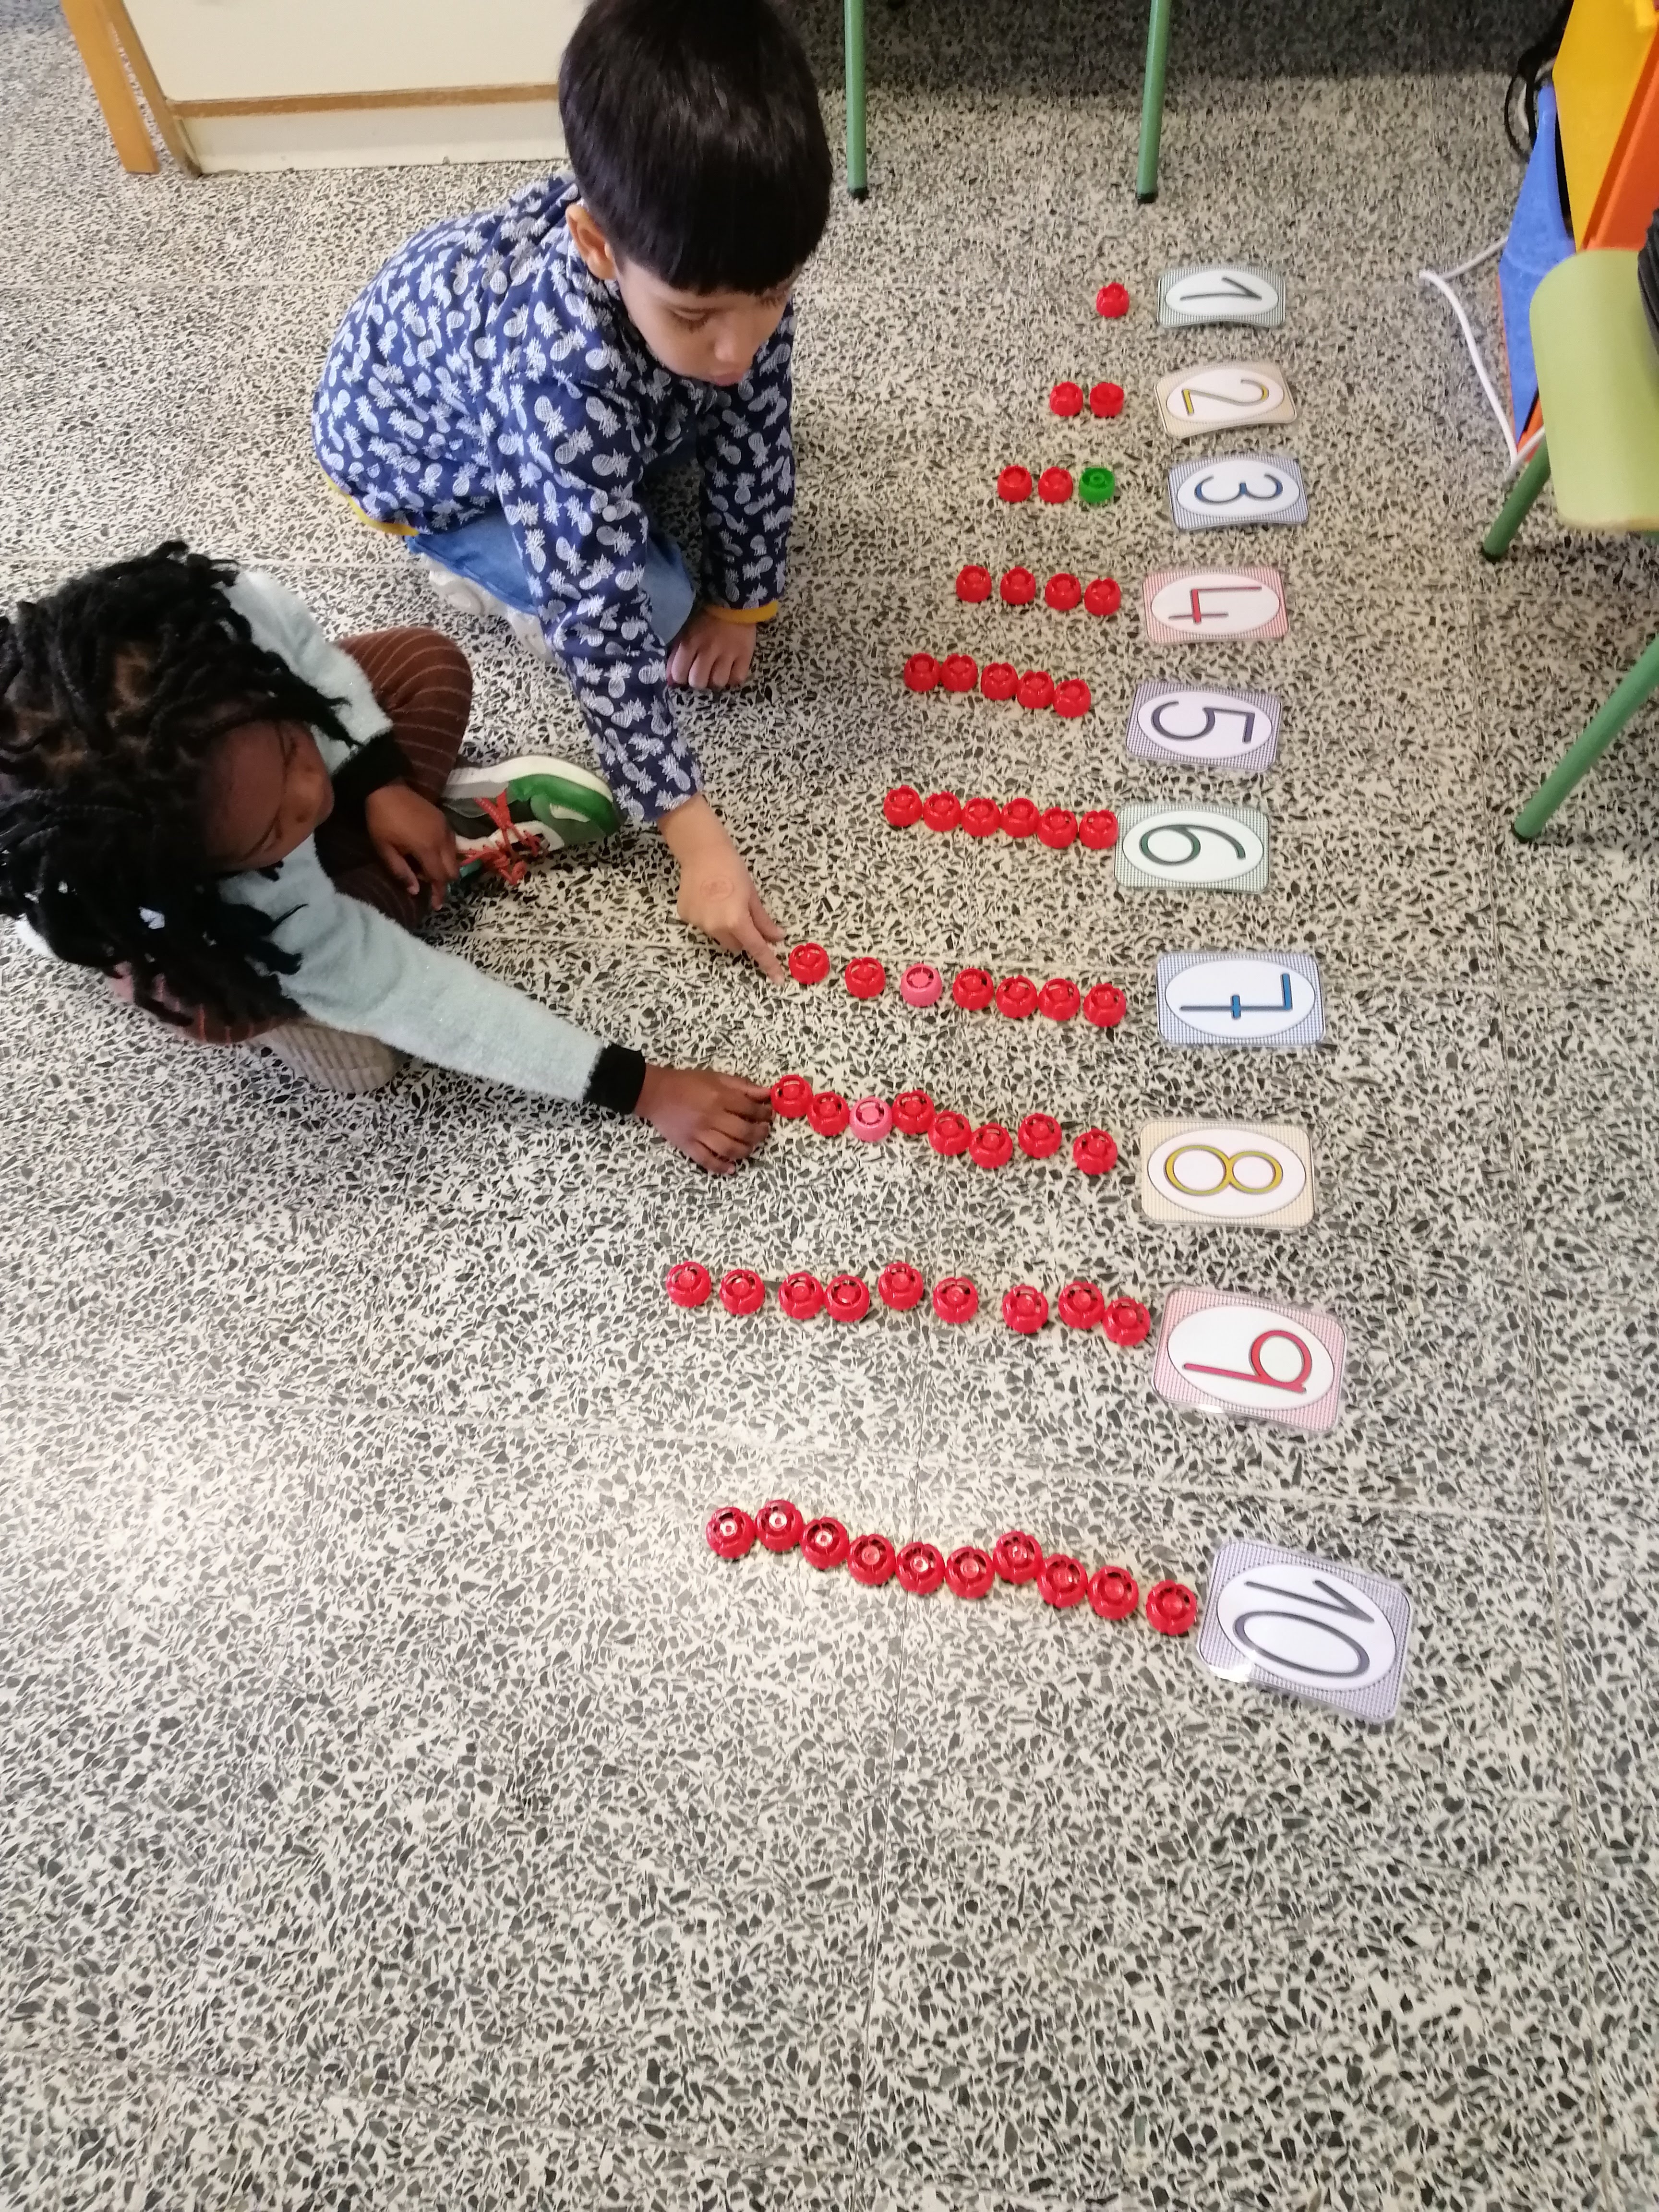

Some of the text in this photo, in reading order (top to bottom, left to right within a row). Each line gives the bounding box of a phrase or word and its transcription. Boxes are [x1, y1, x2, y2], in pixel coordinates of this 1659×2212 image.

[1180, 276, 1262, 301] 1
[1182, 379, 1269, 415] 2
[1195, 474, 1282, 505] 3
[1168, 587, 1262, 624] 4
[1151, 701, 1255, 743] 5
[1140, 824, 1246, 865] 6
[1179, 973, 1292, 1019] 7
[1166, 1145, 1283, 1195] 8
[1184, 1330, 1312, 1395] 9
[1234, 1579, 1374, 1678] 10
